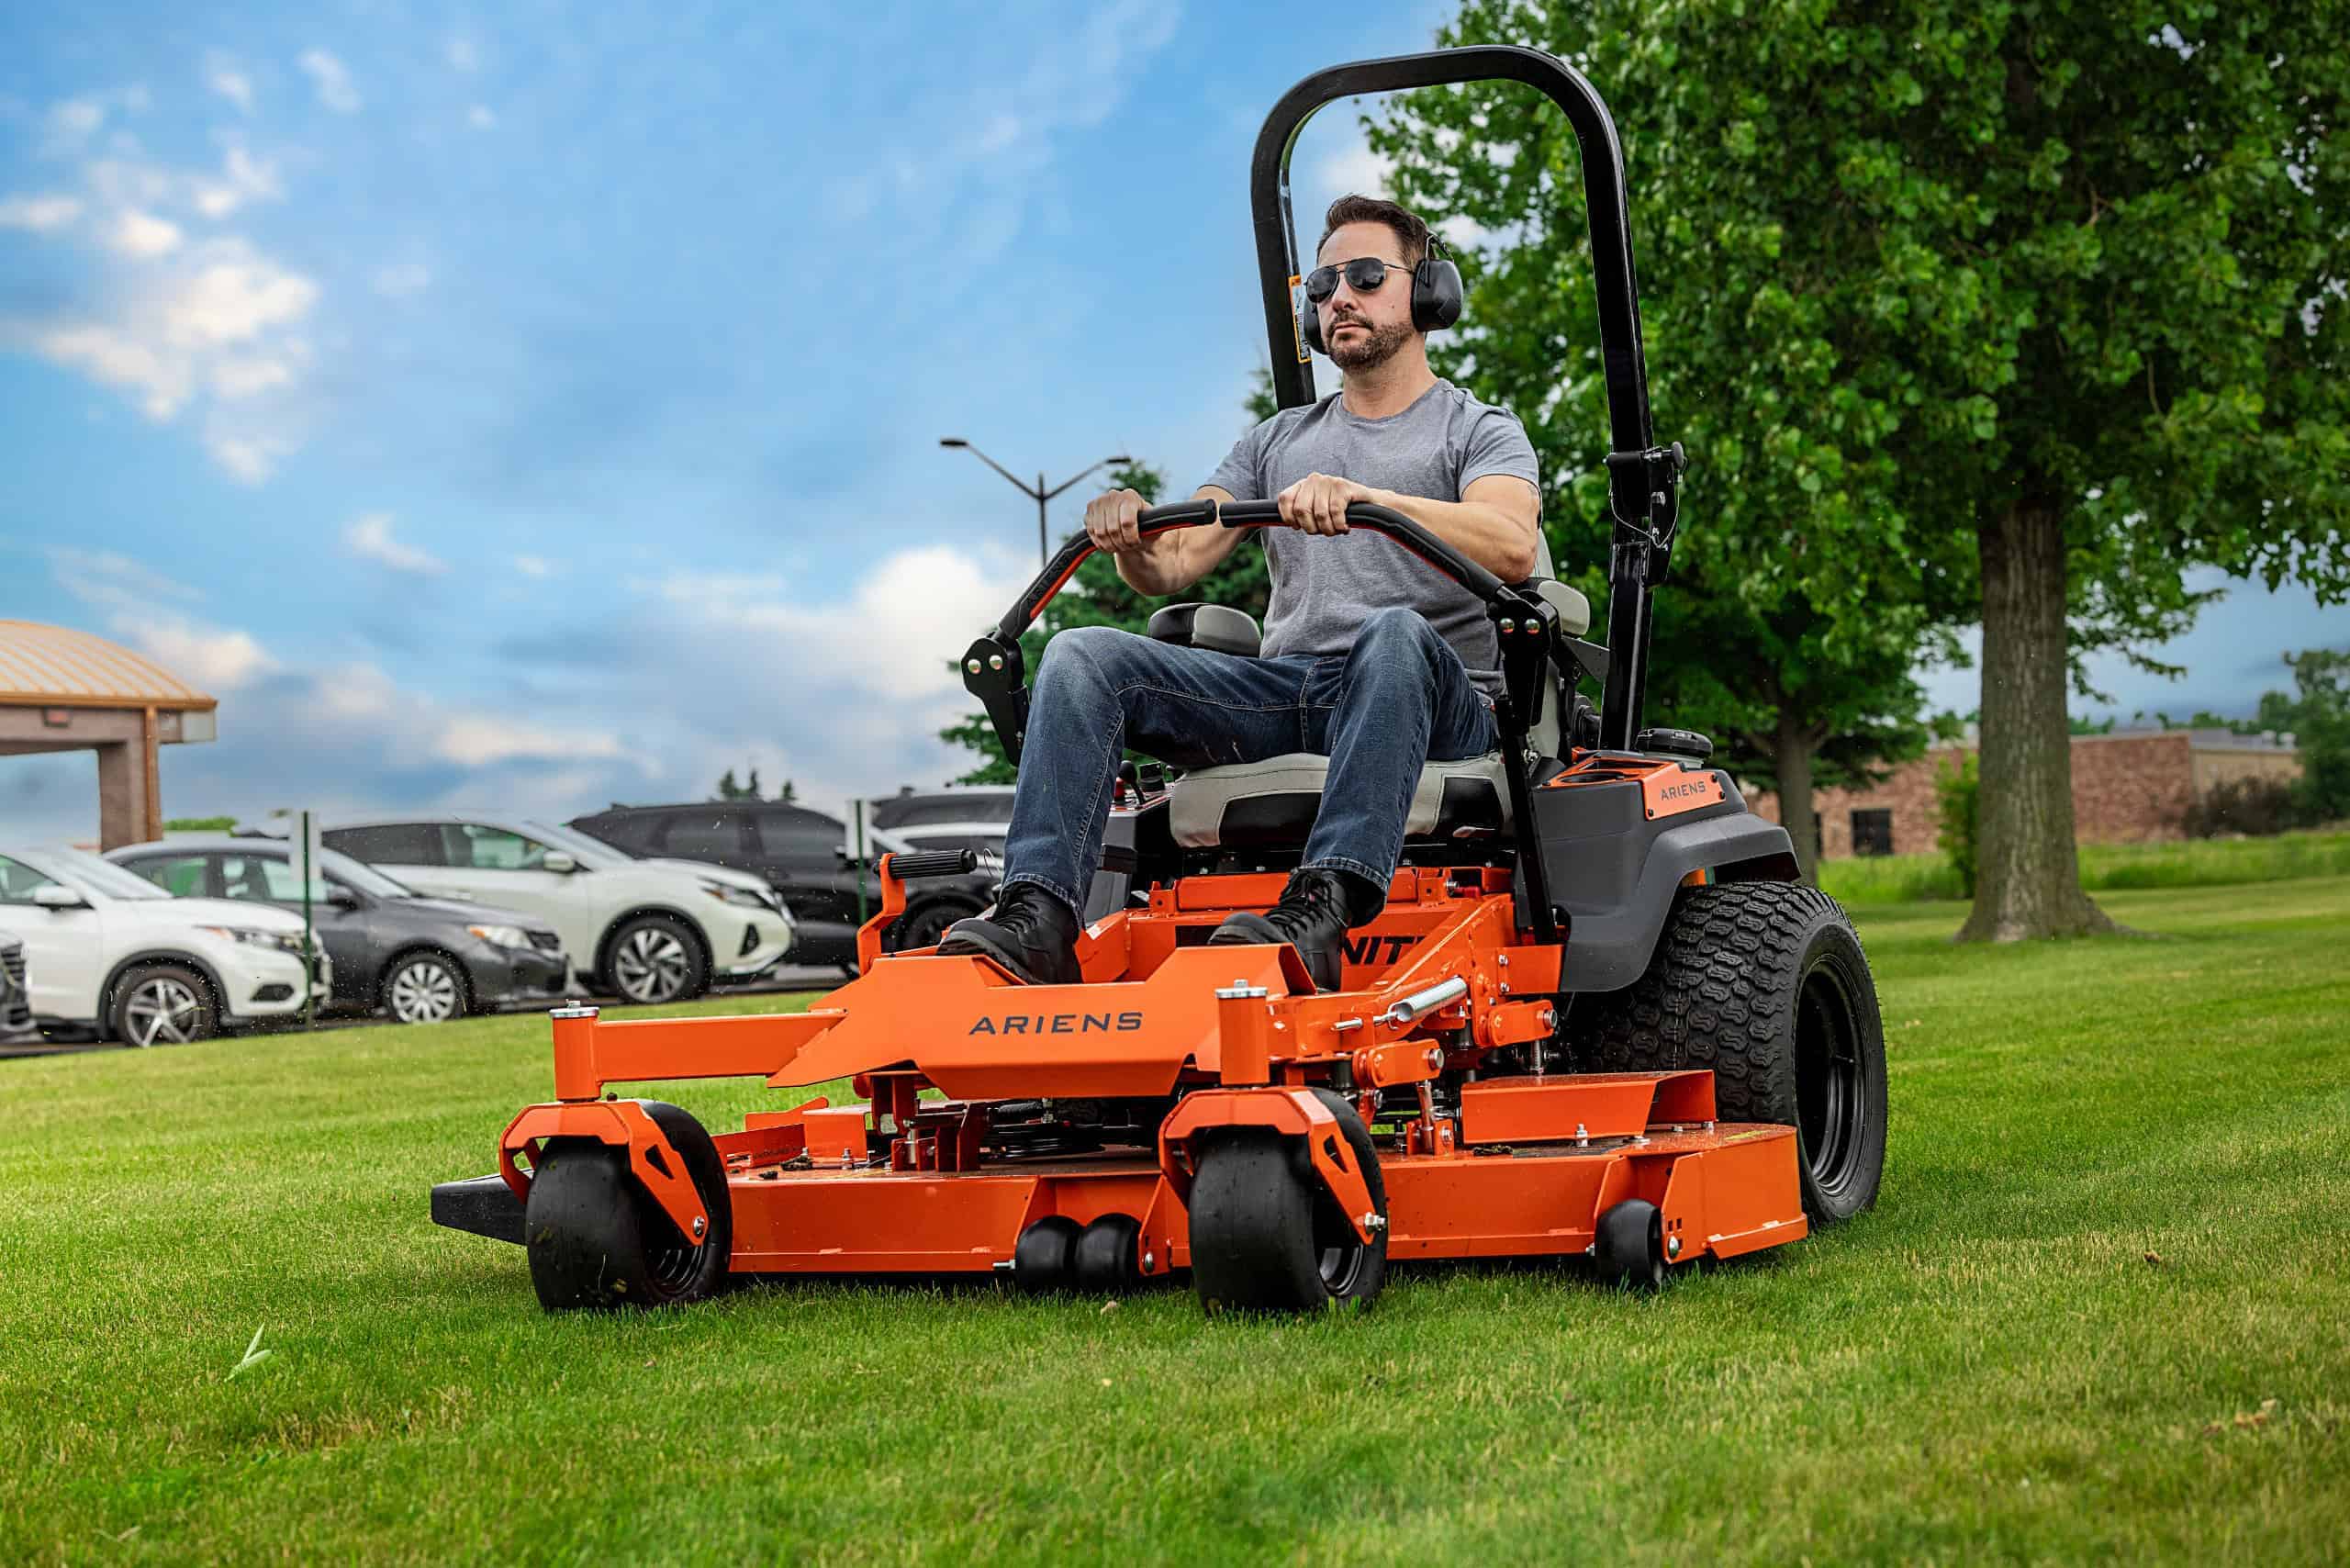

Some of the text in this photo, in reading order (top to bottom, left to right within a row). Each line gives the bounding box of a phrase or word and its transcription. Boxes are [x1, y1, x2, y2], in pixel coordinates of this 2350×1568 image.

[1661, 781, 1706, 801] ARIENS
[1338, 935, 1427, 965] NIT
[968, 1012, 1143, 1036] ARIENS
